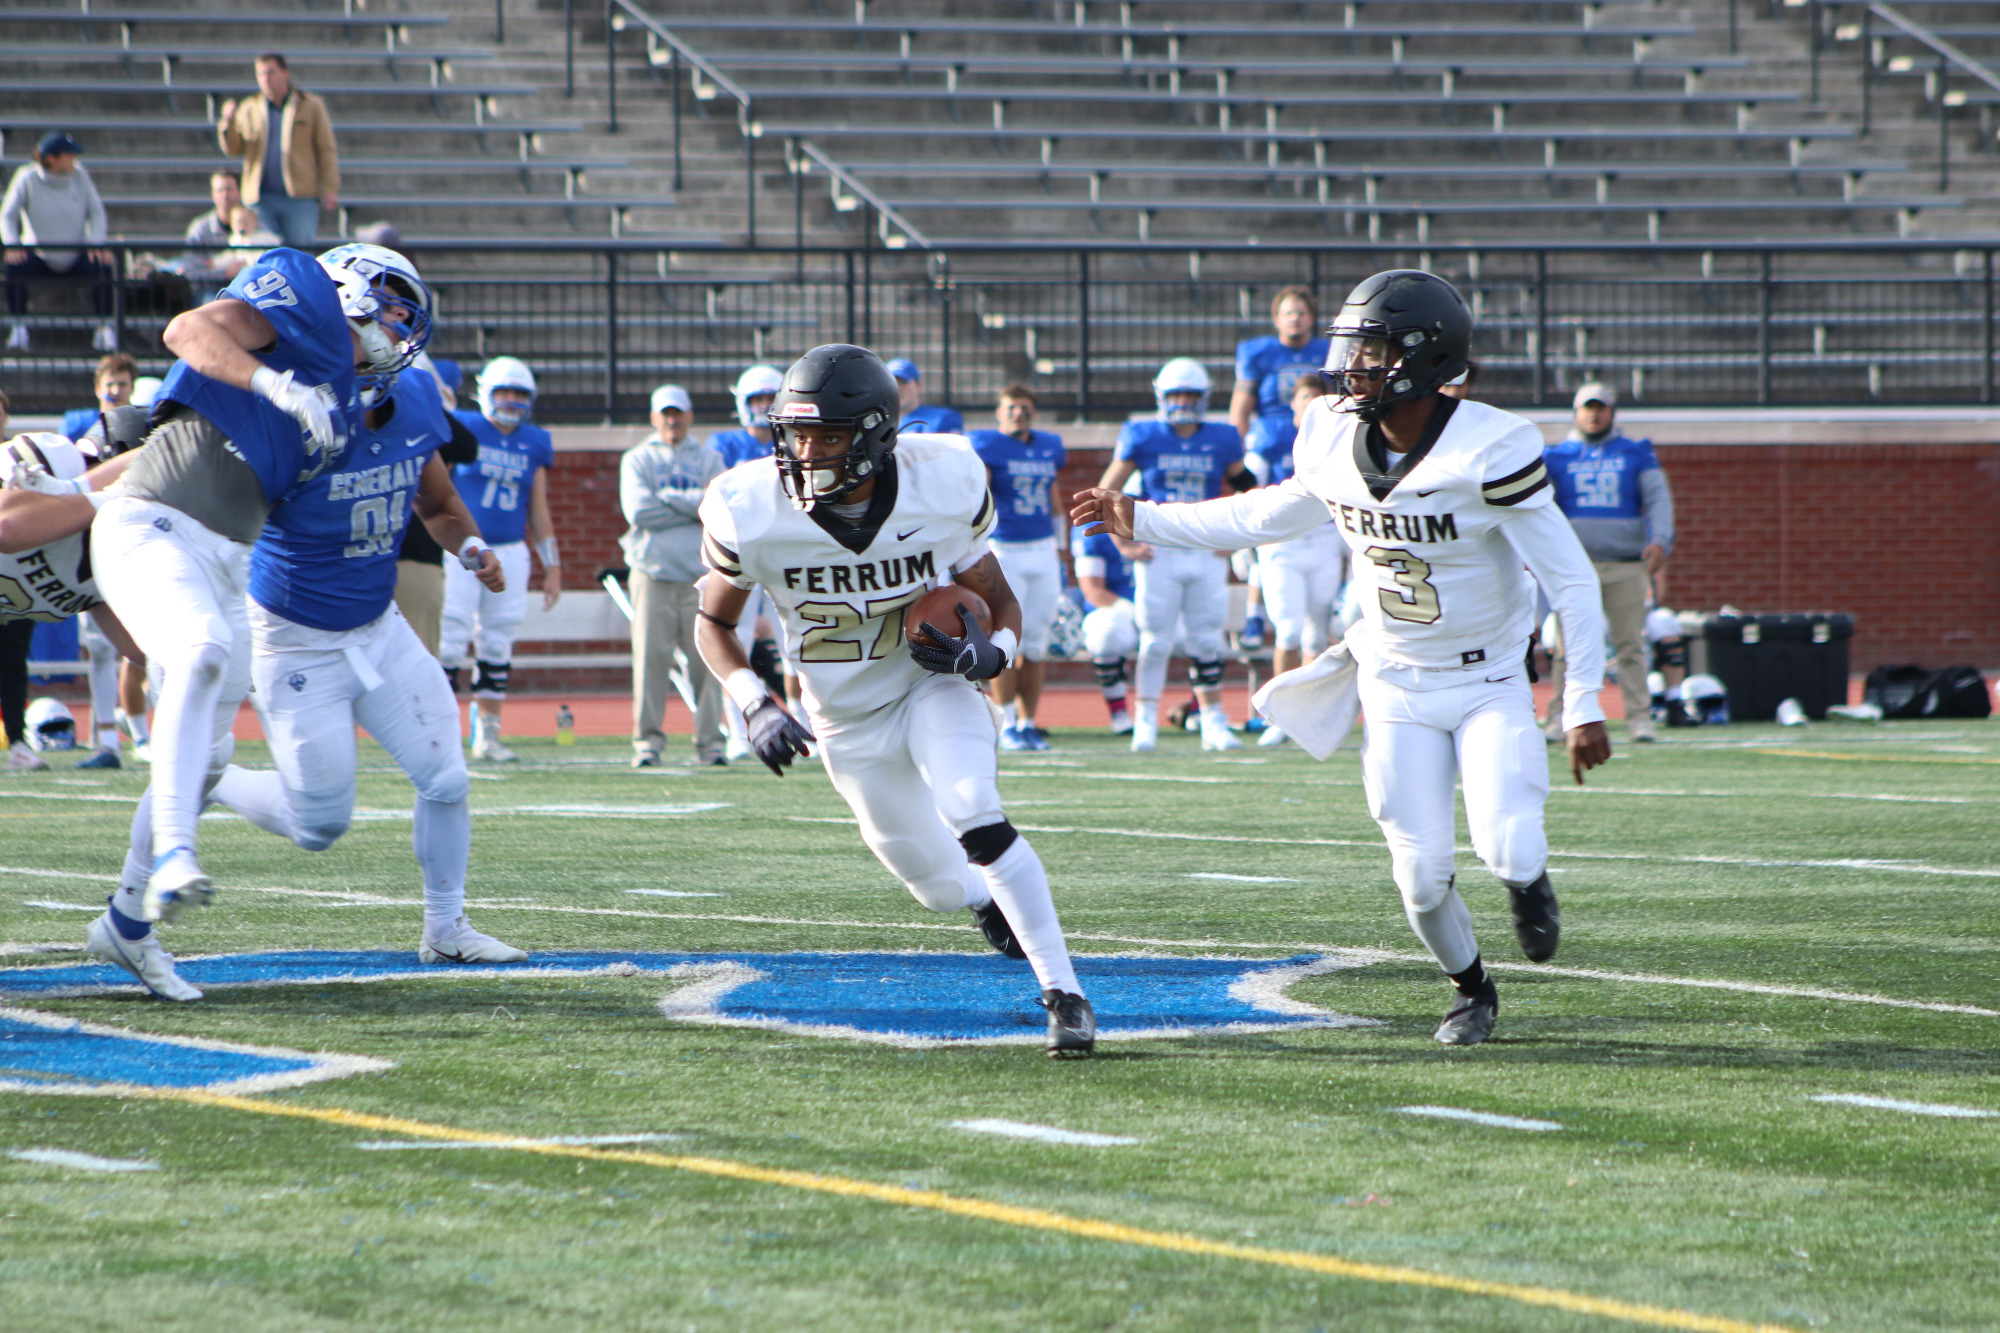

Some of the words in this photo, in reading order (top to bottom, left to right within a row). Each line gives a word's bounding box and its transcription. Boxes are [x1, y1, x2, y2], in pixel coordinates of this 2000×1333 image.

[243, 270, 299, 310] 97
[480, 463, 523, 511] 75
[1013, 476, 1050, 516] 34
[1574, 471, 1620, 508] 58
[343, 490, 407, 558] 91
[784, 551, 936, 594] FERRUM
[1364, 545, 1442, 625] 3
[795, 583, 928, 664] 27
